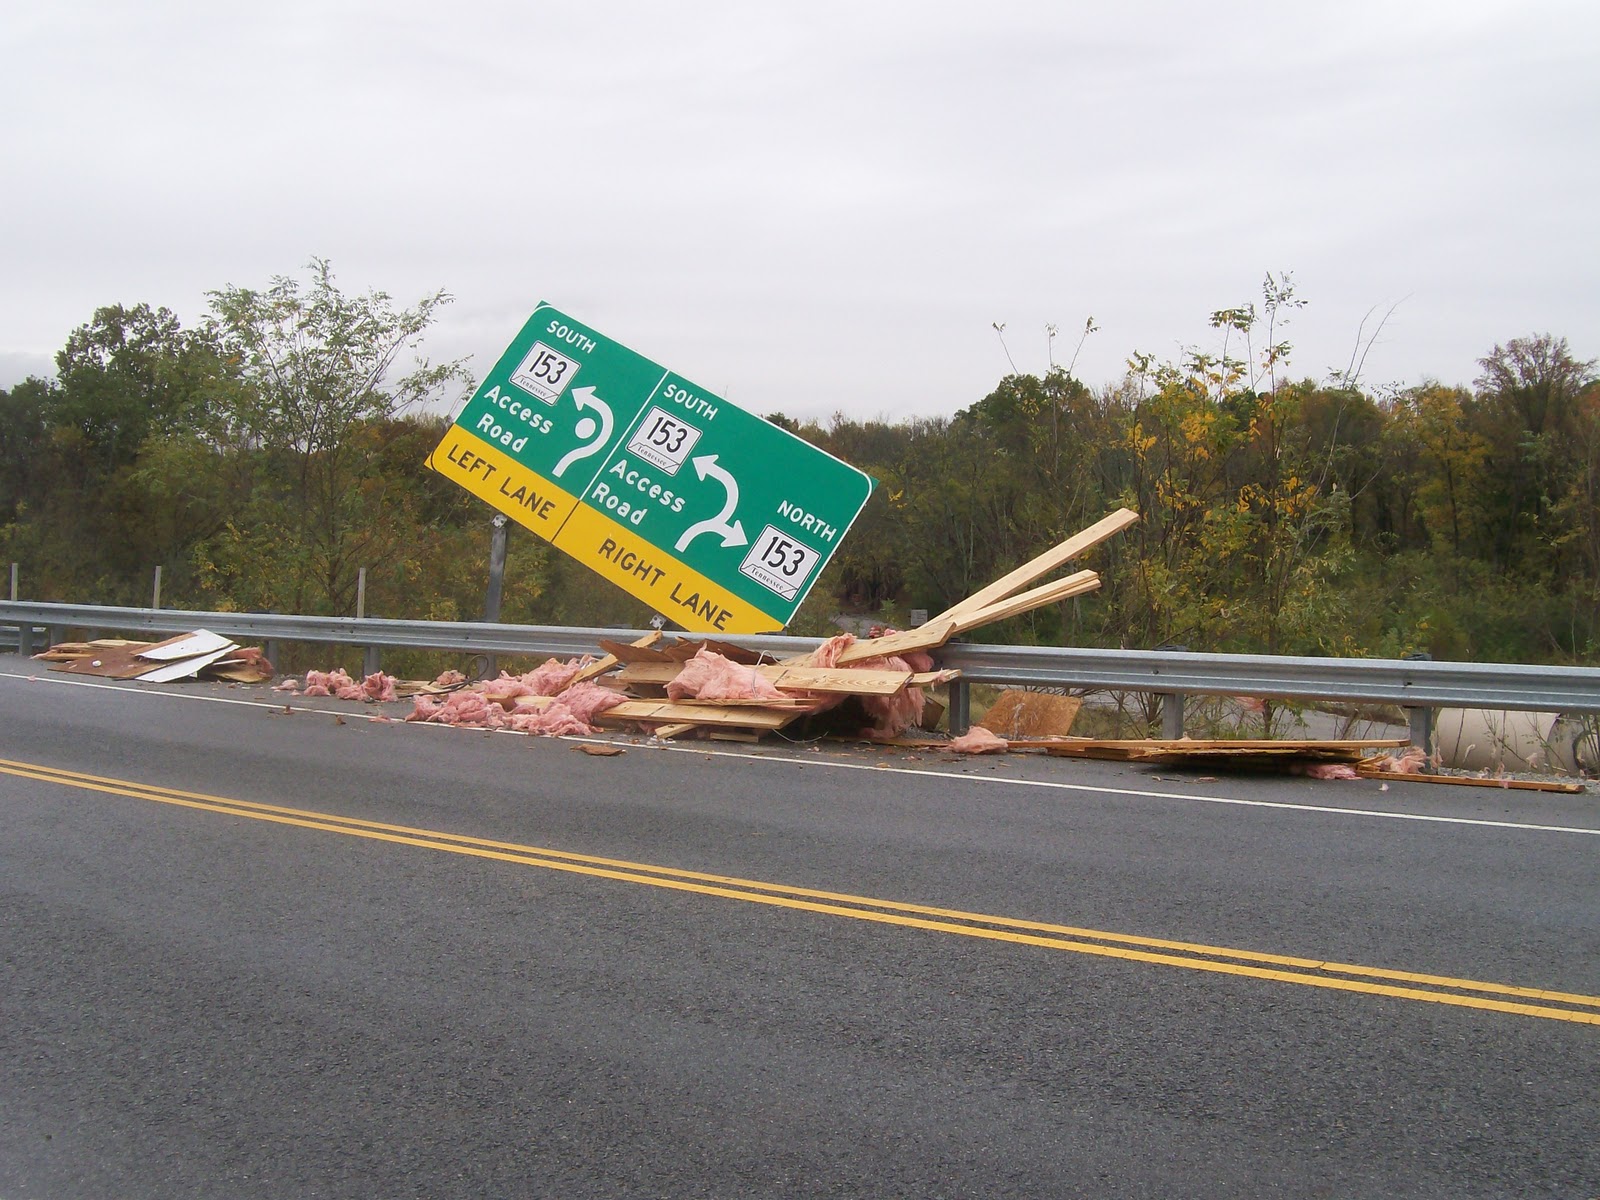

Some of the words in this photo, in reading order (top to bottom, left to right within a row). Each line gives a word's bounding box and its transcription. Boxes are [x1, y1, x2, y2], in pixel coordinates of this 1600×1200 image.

[546, 320, 597, 354] SOUTH
[519, 377, 549, 397] Tennessee
[528, 350, 568, 385] 153
[484, 385, 554, 434] Access
[663, 383, 719, 421] SOUTH
[476, 413, 529, 453] Road
[646, 416, 688, 453] 153
[637, 445, 667, 467] Tennessee
[447, 443, 497, 481] LEFT
[499, 476, 556, 521] LANE
[609, 459, 686, 513] Access
[591, 483, 648, 526] Road
[776, 500, 838, 542] NORTH
[760, 536, 805, 576] 153
[598, 537, 666, 587] RIGHT
[669, 582, 733, 631] LANE
[751, 567, 783, 591] Tennessee
